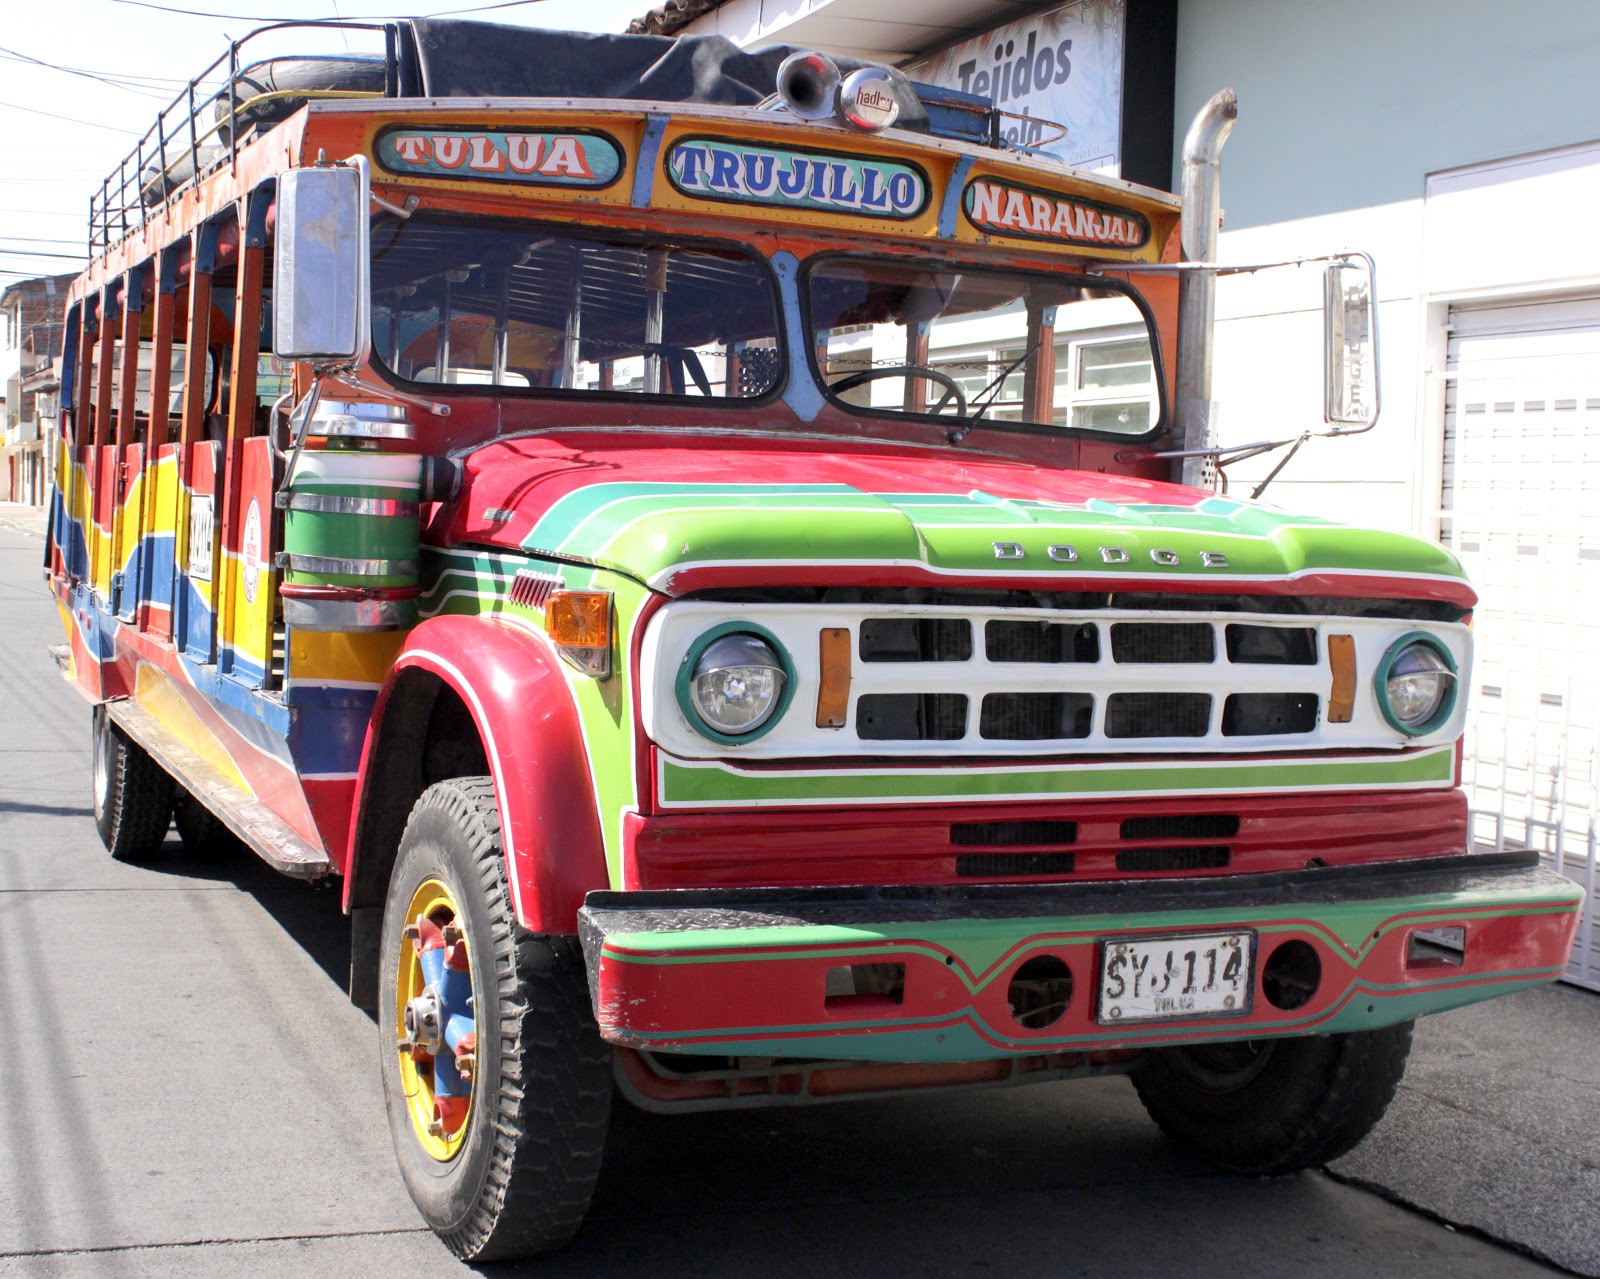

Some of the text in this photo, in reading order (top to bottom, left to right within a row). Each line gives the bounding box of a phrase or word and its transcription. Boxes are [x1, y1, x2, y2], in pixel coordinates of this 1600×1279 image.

[958, 30, 1072, 108] Tejidos
[394, 135, 596, 179] TULUA
[673, 145, 922, 214] TRUJILLO
[970, 181, 1142, 245] NARANJAL
[992, 541, 1230, 568] DODGE
